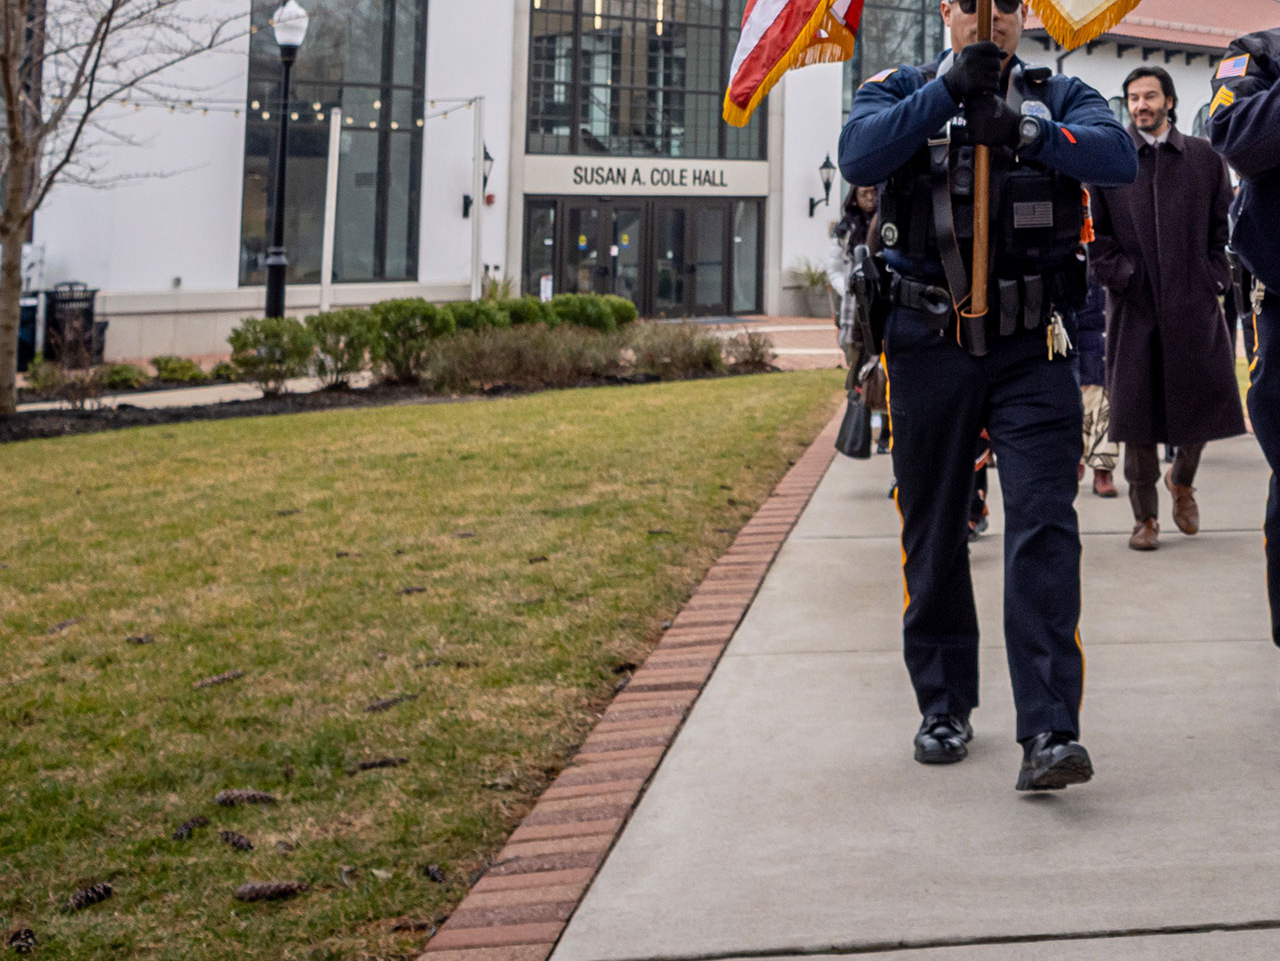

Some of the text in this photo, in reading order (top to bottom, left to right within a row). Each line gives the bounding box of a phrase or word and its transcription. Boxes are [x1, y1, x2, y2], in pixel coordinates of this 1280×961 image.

[573, 166, 728, 188] SUSAN A. COLE HALL
